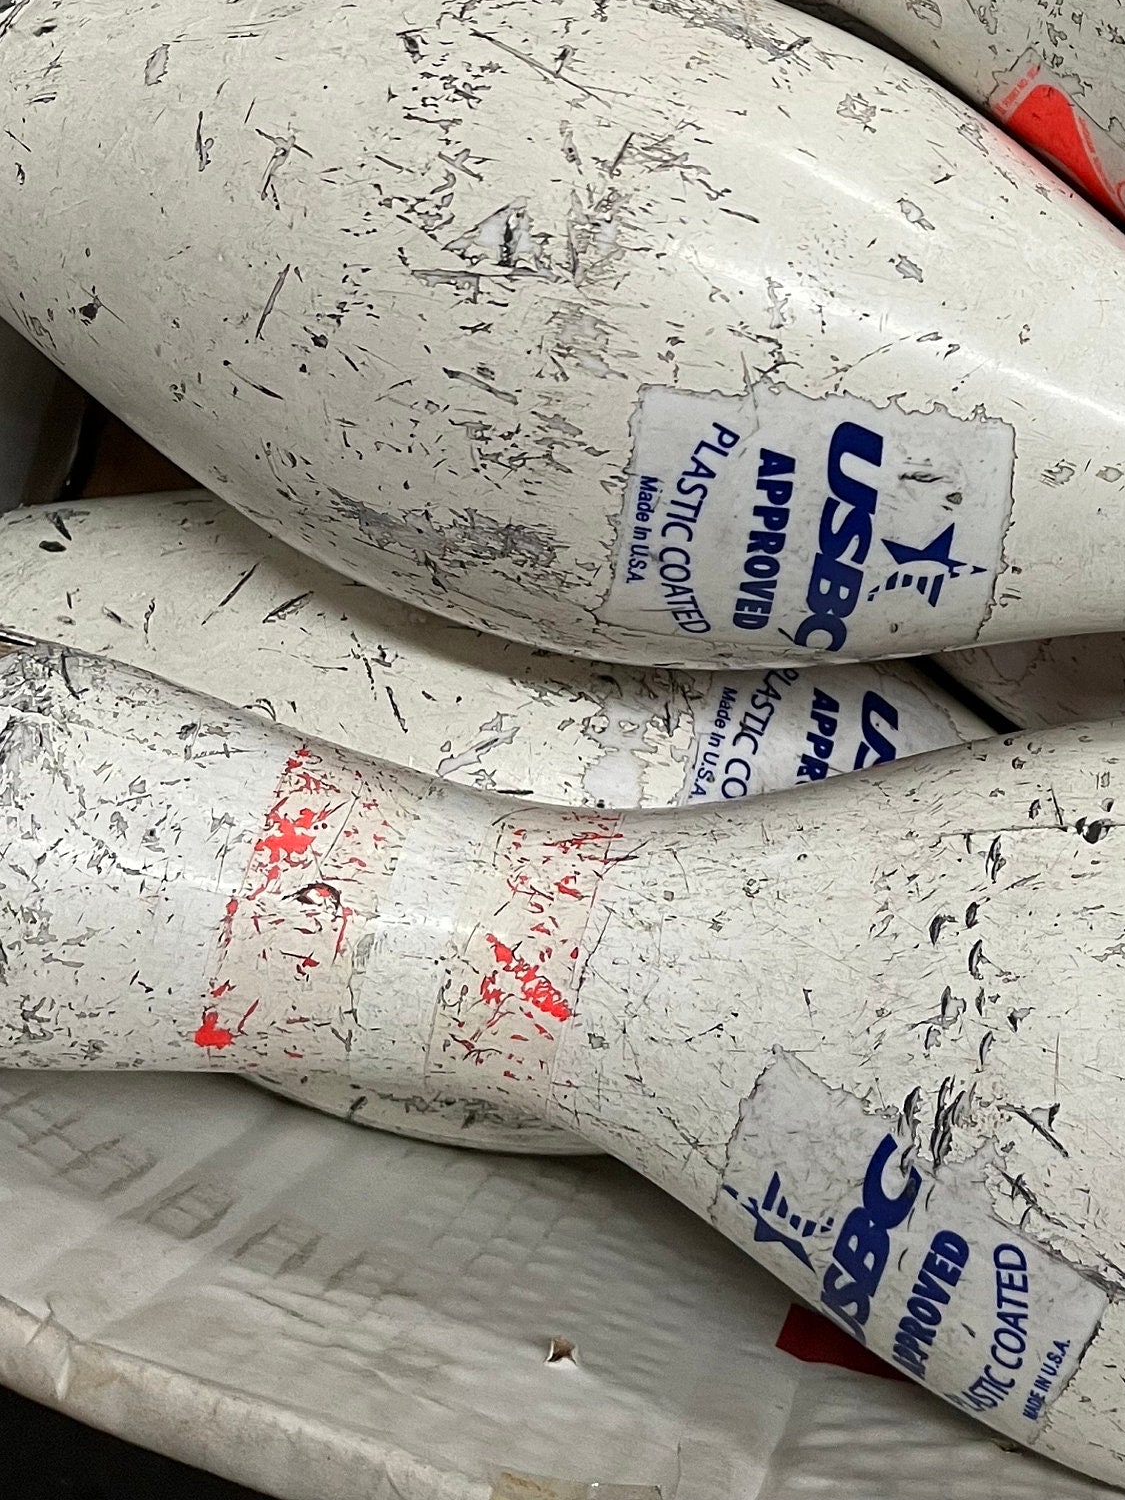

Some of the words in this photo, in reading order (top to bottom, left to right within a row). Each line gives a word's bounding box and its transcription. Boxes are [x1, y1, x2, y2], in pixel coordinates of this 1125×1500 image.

[635, 475, 659, 523] Made
[661, 421, 740, 543] PLASTIC
[632, 525, 652, 541] In
[732, 447, 797, 630] APPROVED
[794, 421, 884, 652] USBC
[658, 546, 712, 634] COATED
[714, 686, 738, 729] Made
[707, 731, 726, 748] In
[990, 1243, 1029, 1370] COATED
[1022, 1389, 1045, 1420] MADE
[1033, 1374, 1053, 1393] IN
